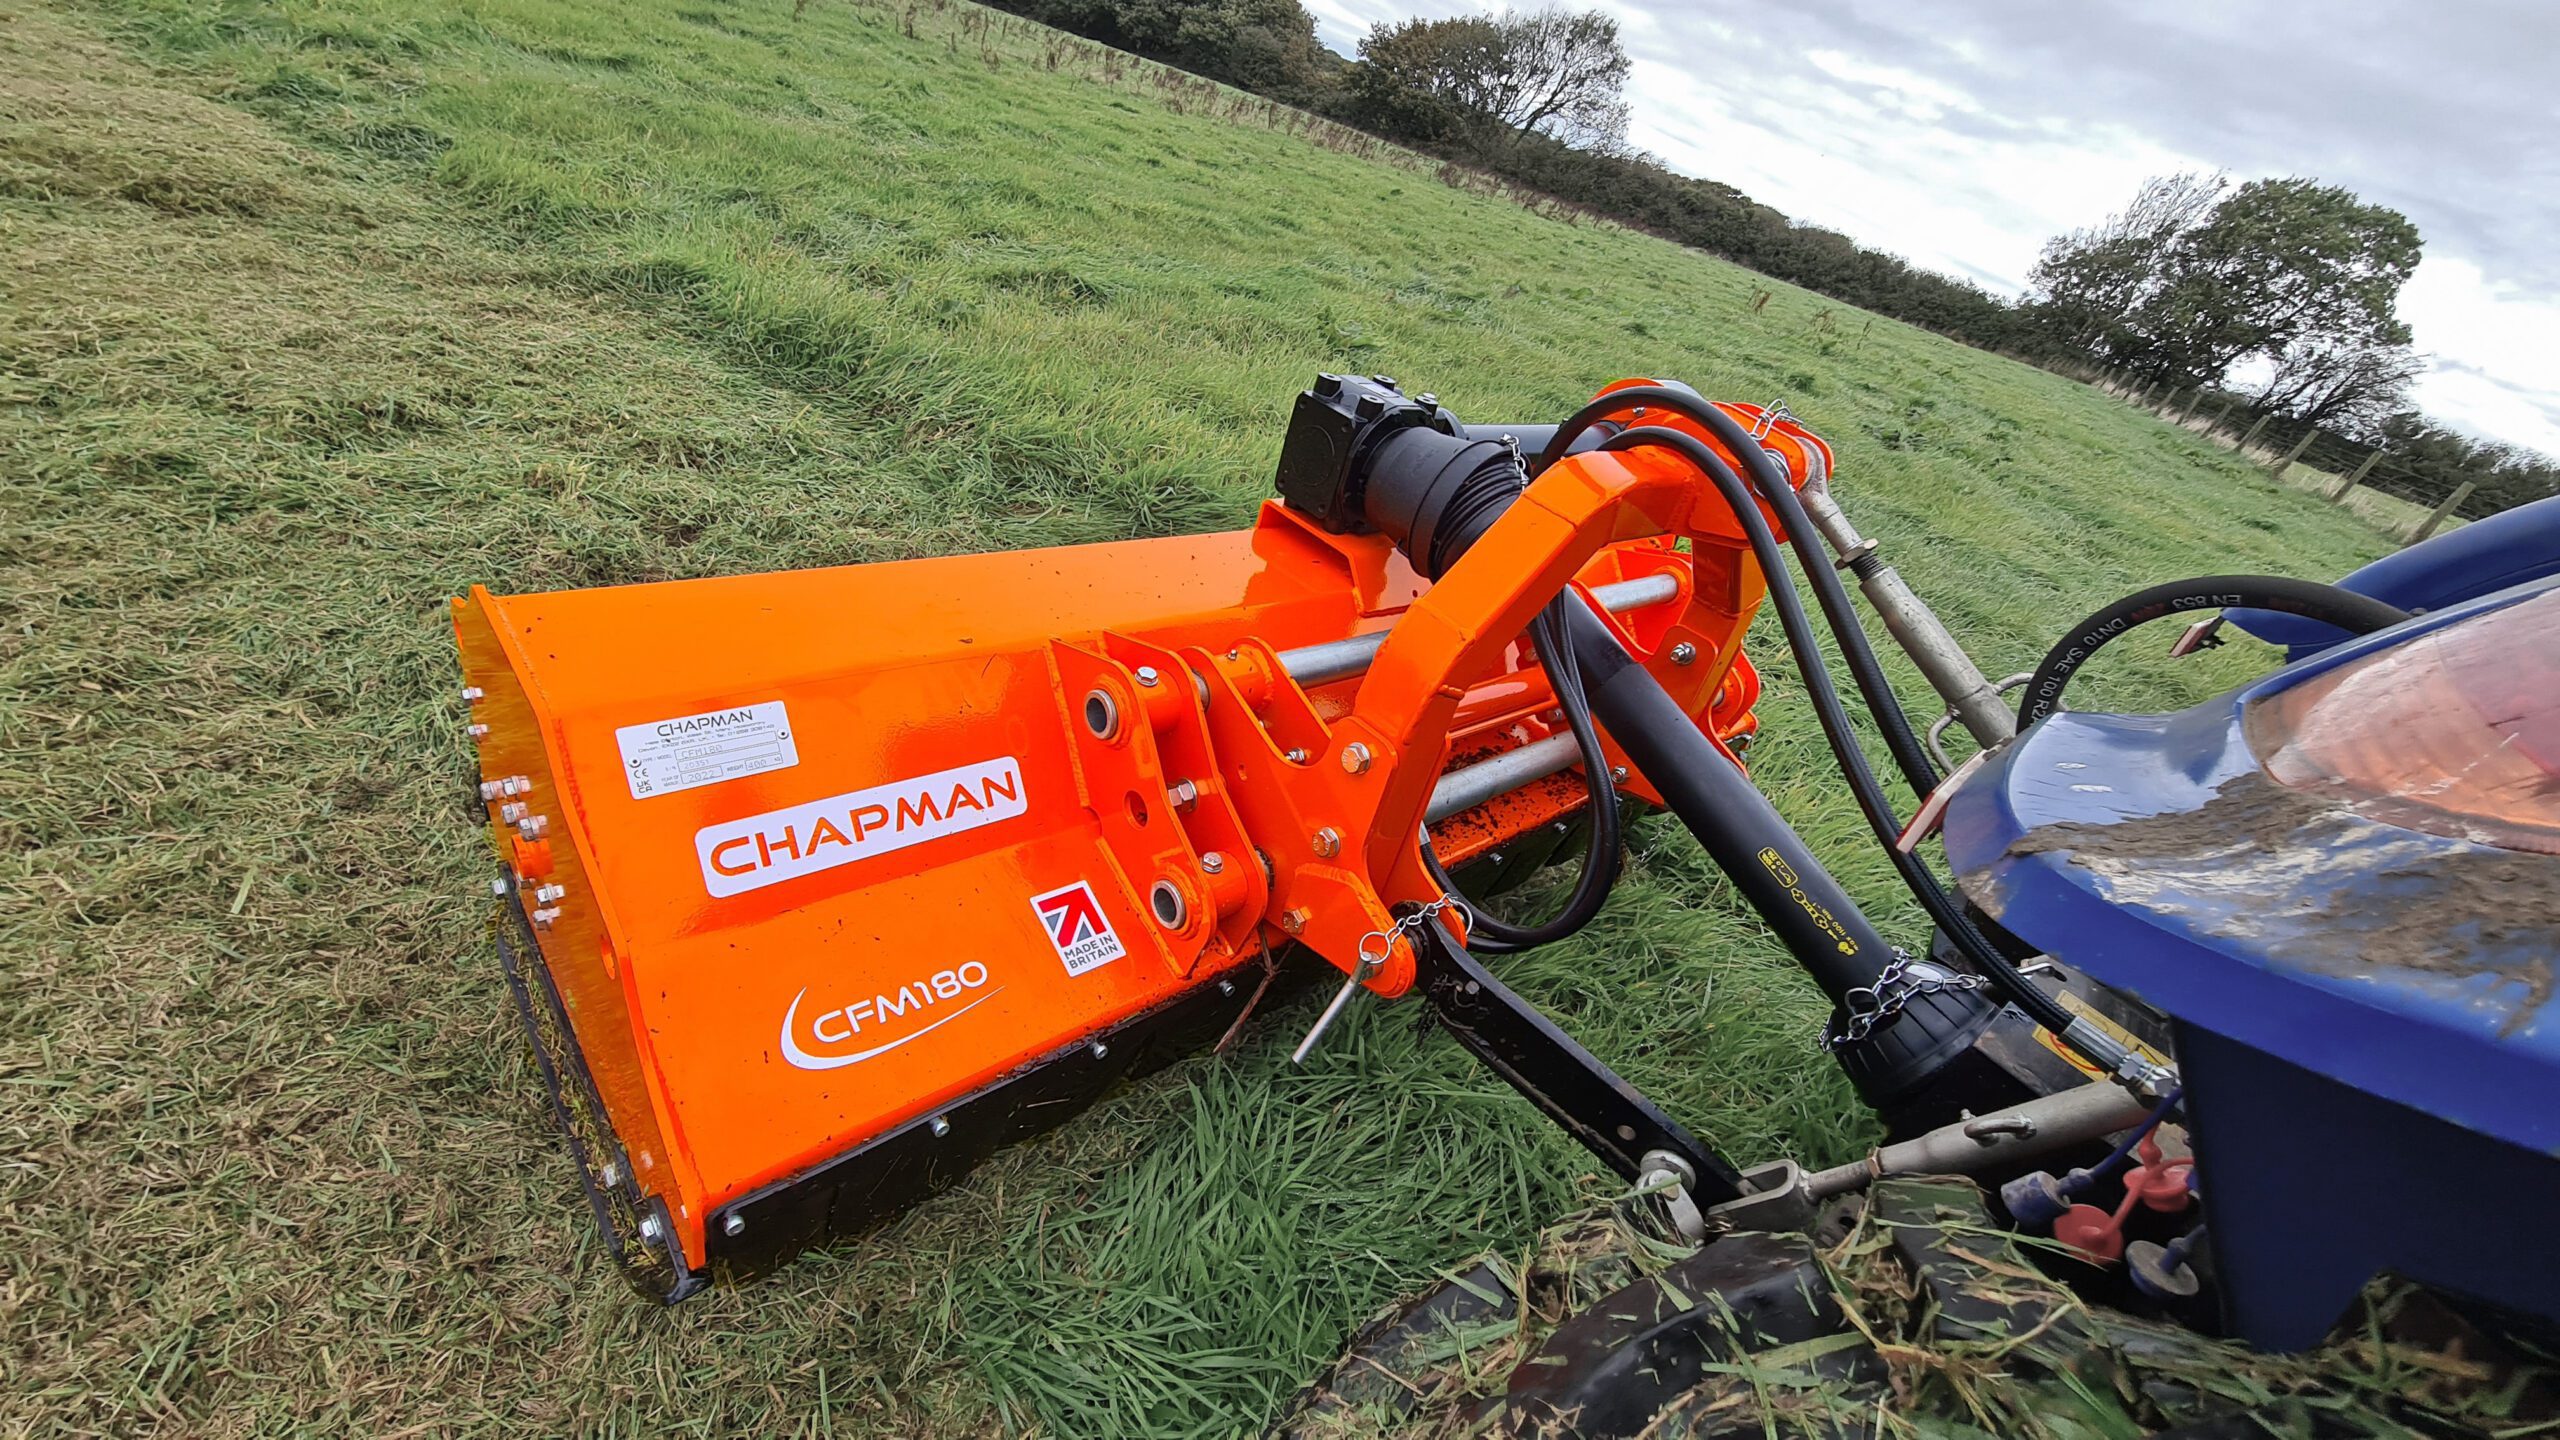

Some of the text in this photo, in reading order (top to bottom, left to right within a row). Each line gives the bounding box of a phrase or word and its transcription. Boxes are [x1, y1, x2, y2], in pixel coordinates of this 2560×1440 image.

[2172, 595, 2207, 609] 853
[2212, 594, 2242, 606] EN
[2083, 617, 2128, 646] DN10
[2054, 647, 2085, 674] SAE
[2039, 676, 2061, 697] 100
[657, 709, 753, 737] CHAPMAN
[688, 770, 715, 784] 2022
[710, 771, 1017, 877] CHAPMAN
[1064, 934, 1114, 960] MADE IN
[1069, 943, 1119, 969] BRITAIN
[813, 960, 988, 1043] CFM180
